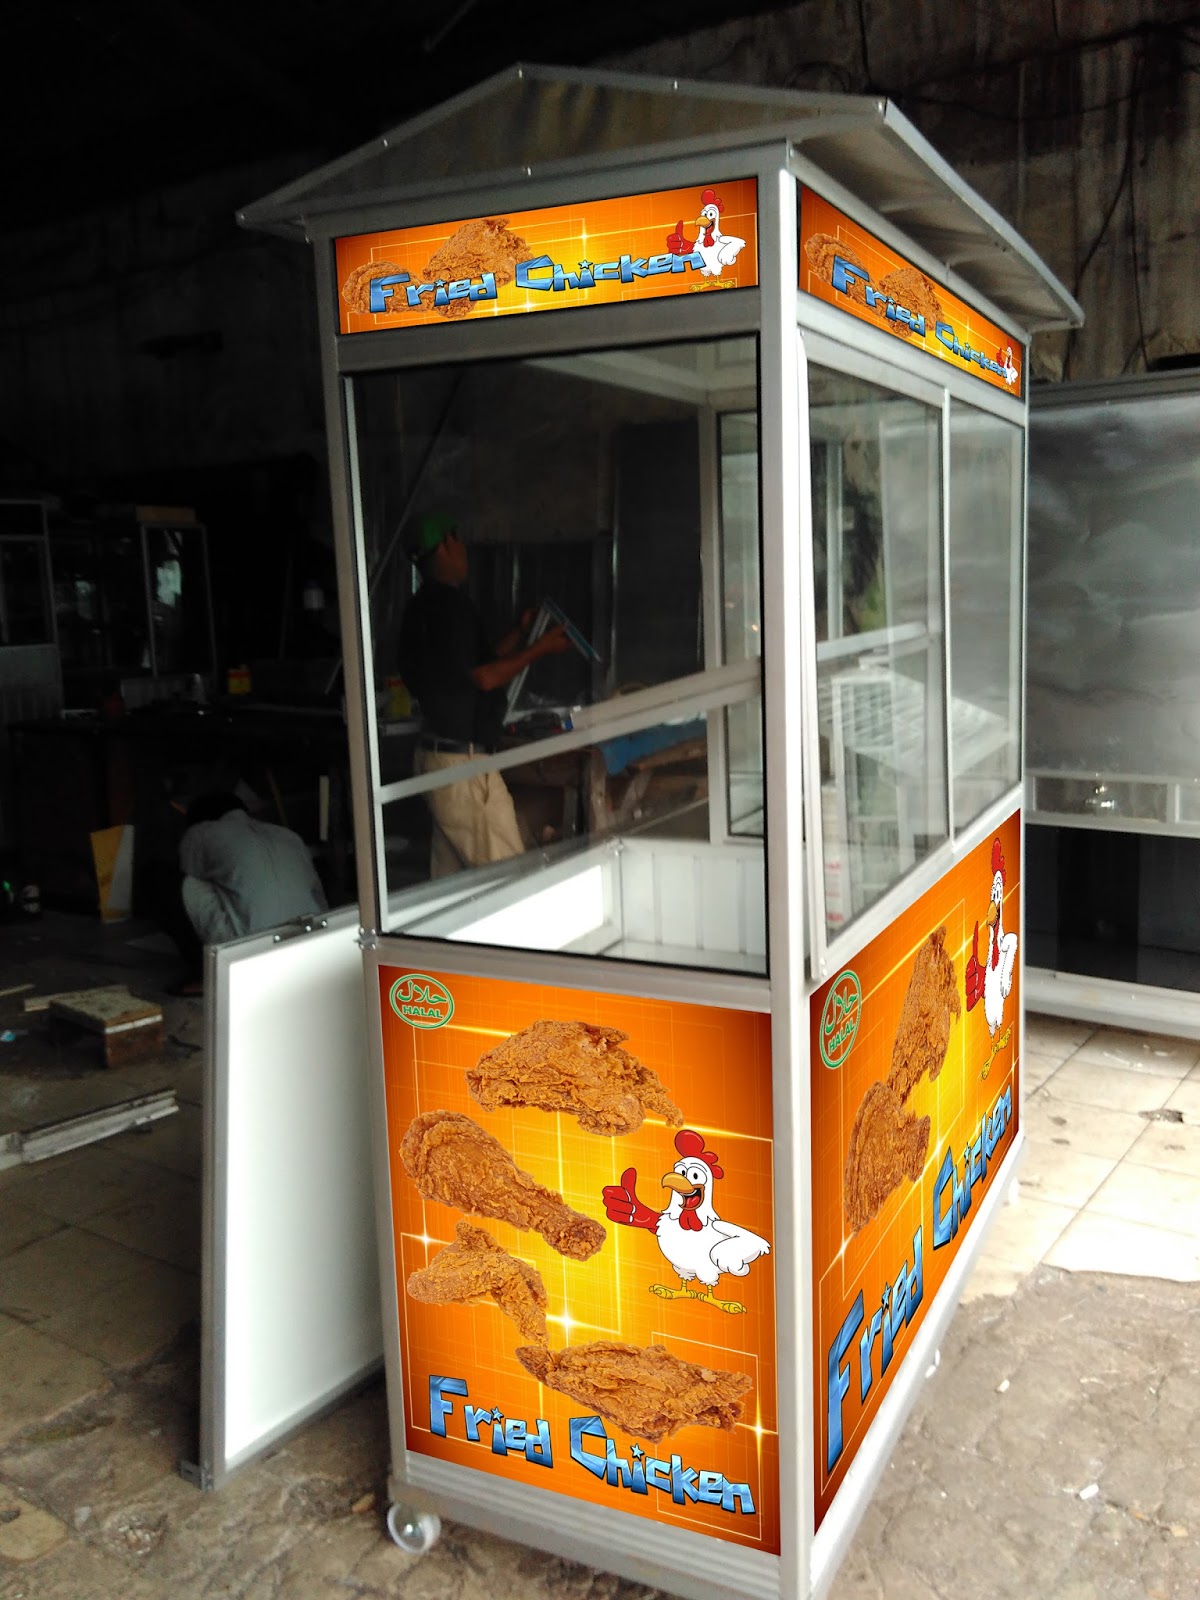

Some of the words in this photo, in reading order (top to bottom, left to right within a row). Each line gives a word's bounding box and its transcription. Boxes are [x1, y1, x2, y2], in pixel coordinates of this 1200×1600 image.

[369, 272, 497, 313] Fried
[515, 251, 707, 290] Chicken
[832, 254, 926, 337] Fried
[935, 320, 1008, 379] Chicken
[396, 980, 448, 1005] حلال
[402, 1005, 444, 1019] HALAL
[828, 1017, 855, 1056] HALAL
[827, 1225, 924, 1474] Fried
[933, 1083, 1012, 1250] Chicken
[429, 1375, 553, 1468] Fried
[569, 1416, 756, 1514] Chicken
